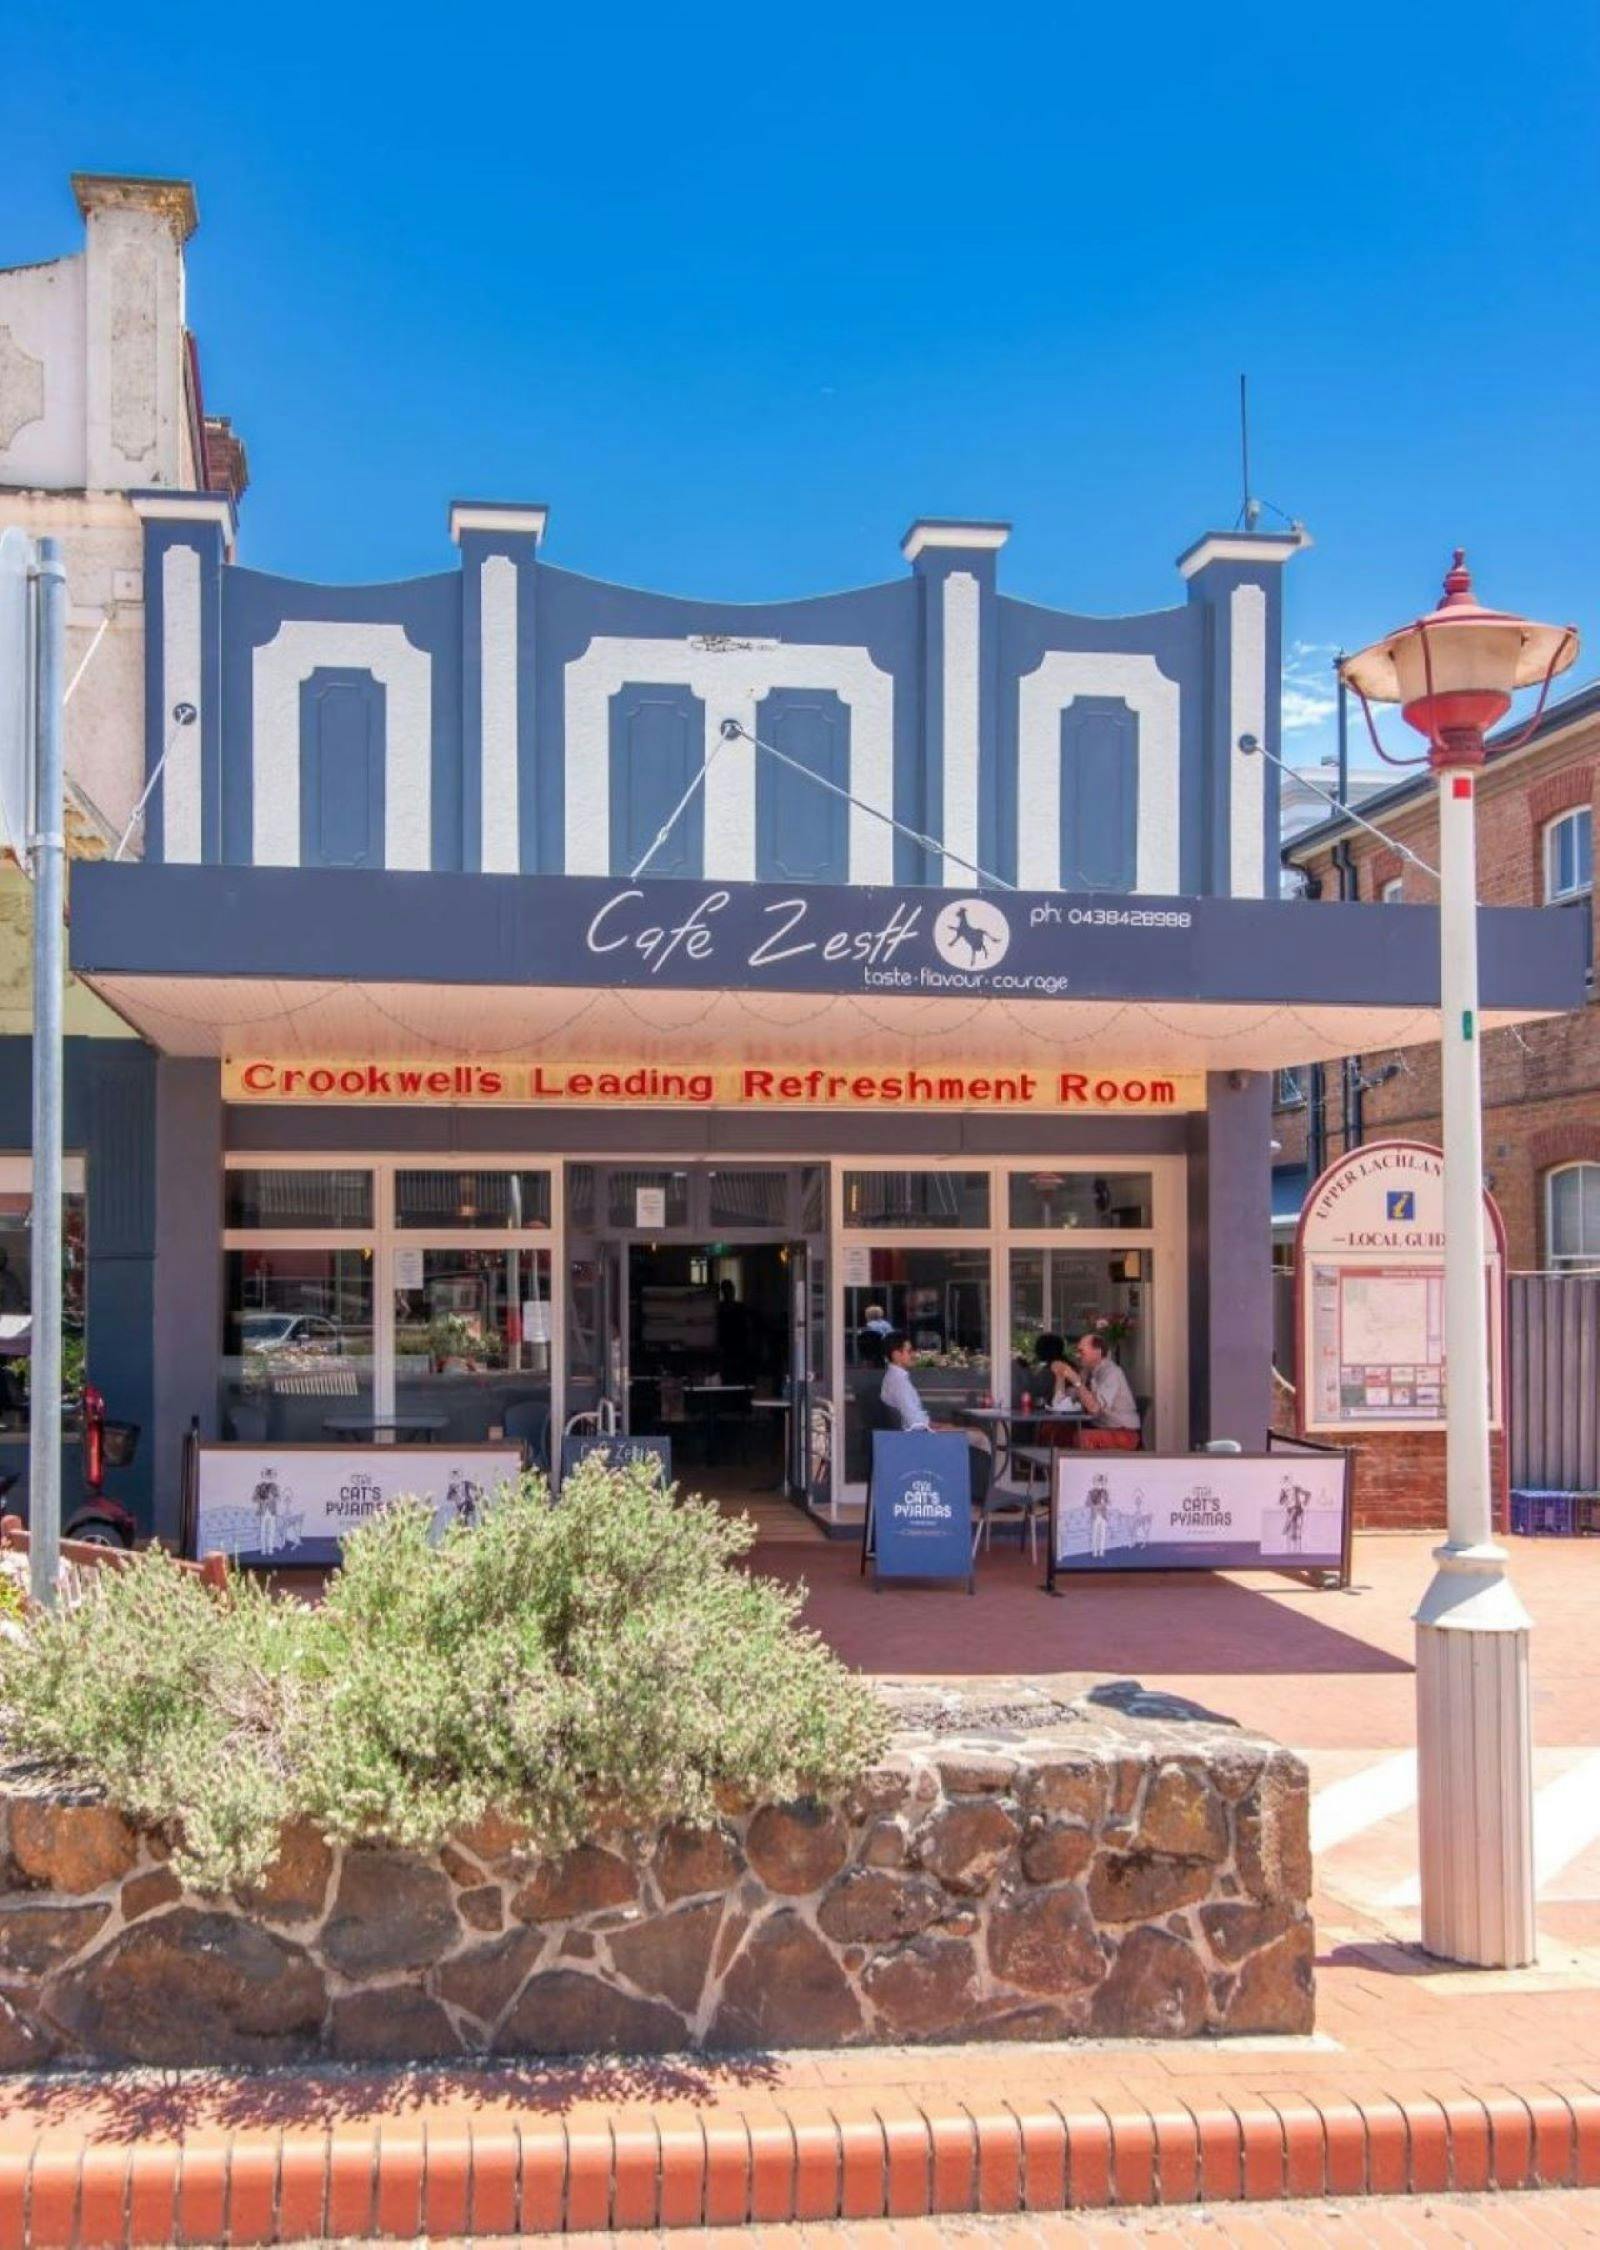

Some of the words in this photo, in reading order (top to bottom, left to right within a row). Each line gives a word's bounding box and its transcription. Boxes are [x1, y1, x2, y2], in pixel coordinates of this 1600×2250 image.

[243, 1064, 502, 1094] Crookwell's
[534, 1067, 712, 1101] Leading
[743, 1070, 1036, 1101] Refreshment
[1060, 1073, 1175, 1104] Room
[1316, 1170, 1358, 1219] UPPER
[1348, 1232, 1401, 1246] LOCAL
[1405, 1232, 1446, 1246] GUID
[340, 1486, 382, 1501] CAT'S
[894, 1503, 952, 1518] PYJAMAS
[1170, 1511, 1232, 1526] PYJAMAS
